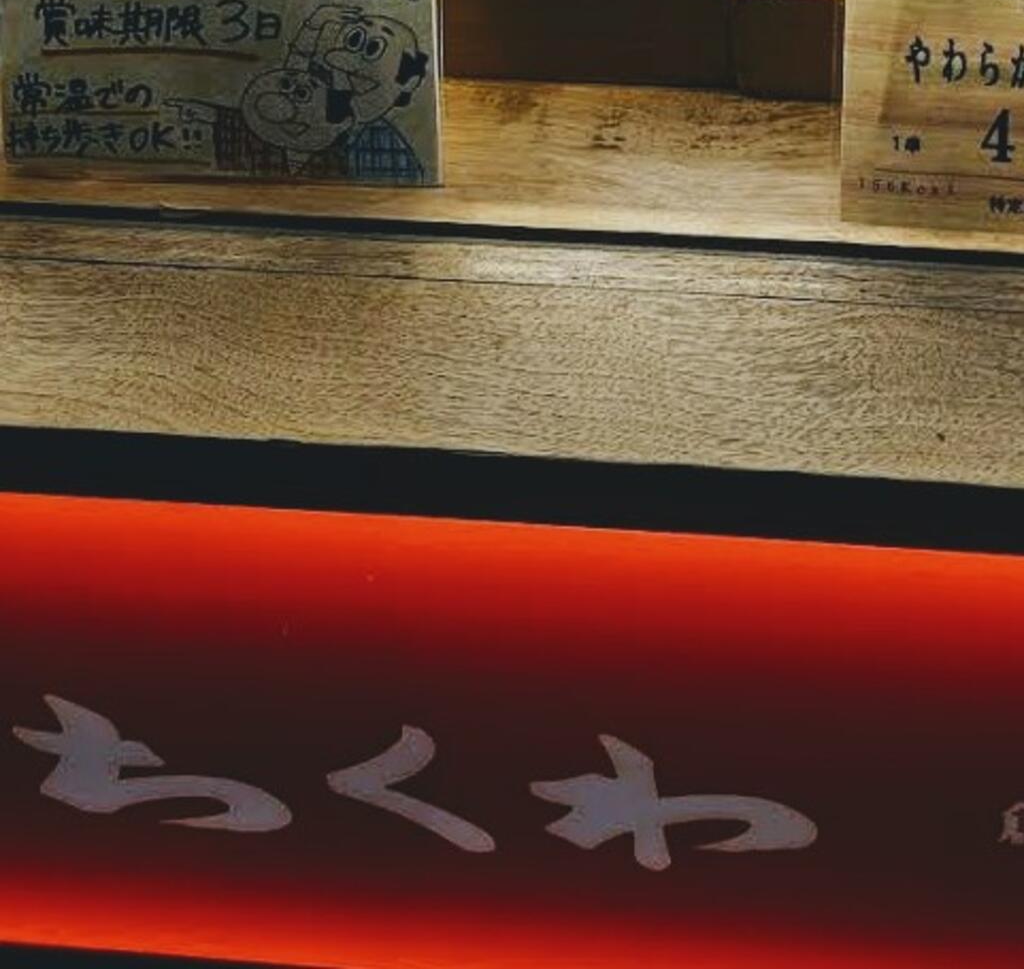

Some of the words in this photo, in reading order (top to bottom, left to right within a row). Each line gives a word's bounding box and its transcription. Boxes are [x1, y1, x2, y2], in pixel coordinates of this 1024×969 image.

[13, 72, 154, 116] 常温での
[12, 693, 819, 871] ちくわ
